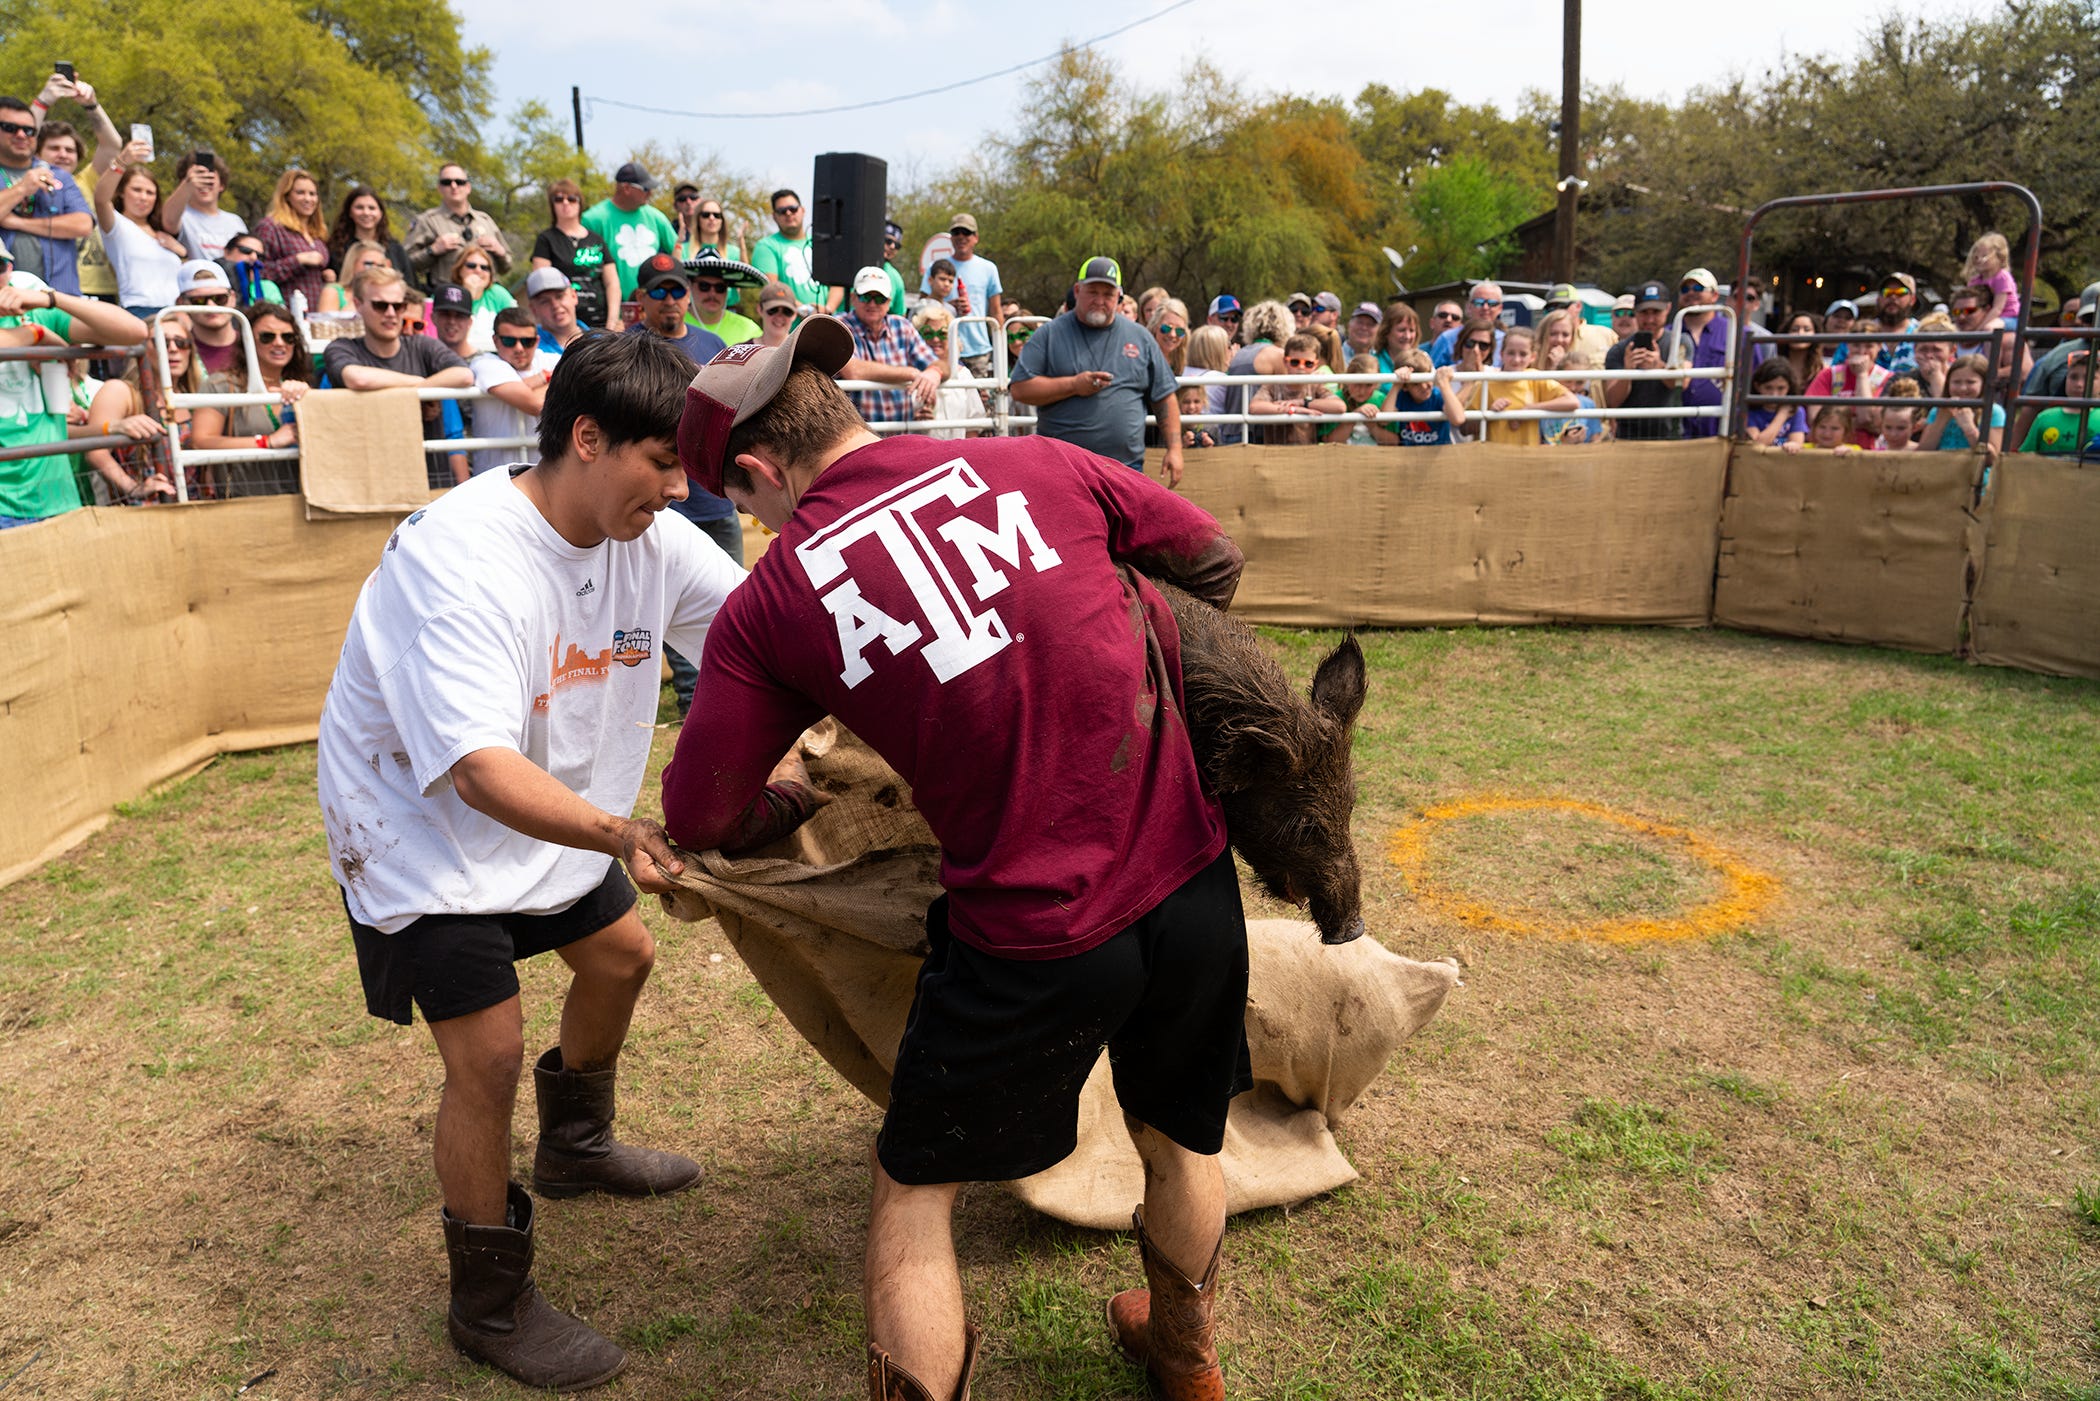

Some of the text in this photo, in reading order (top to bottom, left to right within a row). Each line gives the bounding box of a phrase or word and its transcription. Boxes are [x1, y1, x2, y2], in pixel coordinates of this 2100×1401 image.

[1401, 429, 1438, 443] adidas
[623, 630, 650, 641] FINAL
[613, 640, 650, 656] FOUR
[567, 667, 599, 679] FINAL
